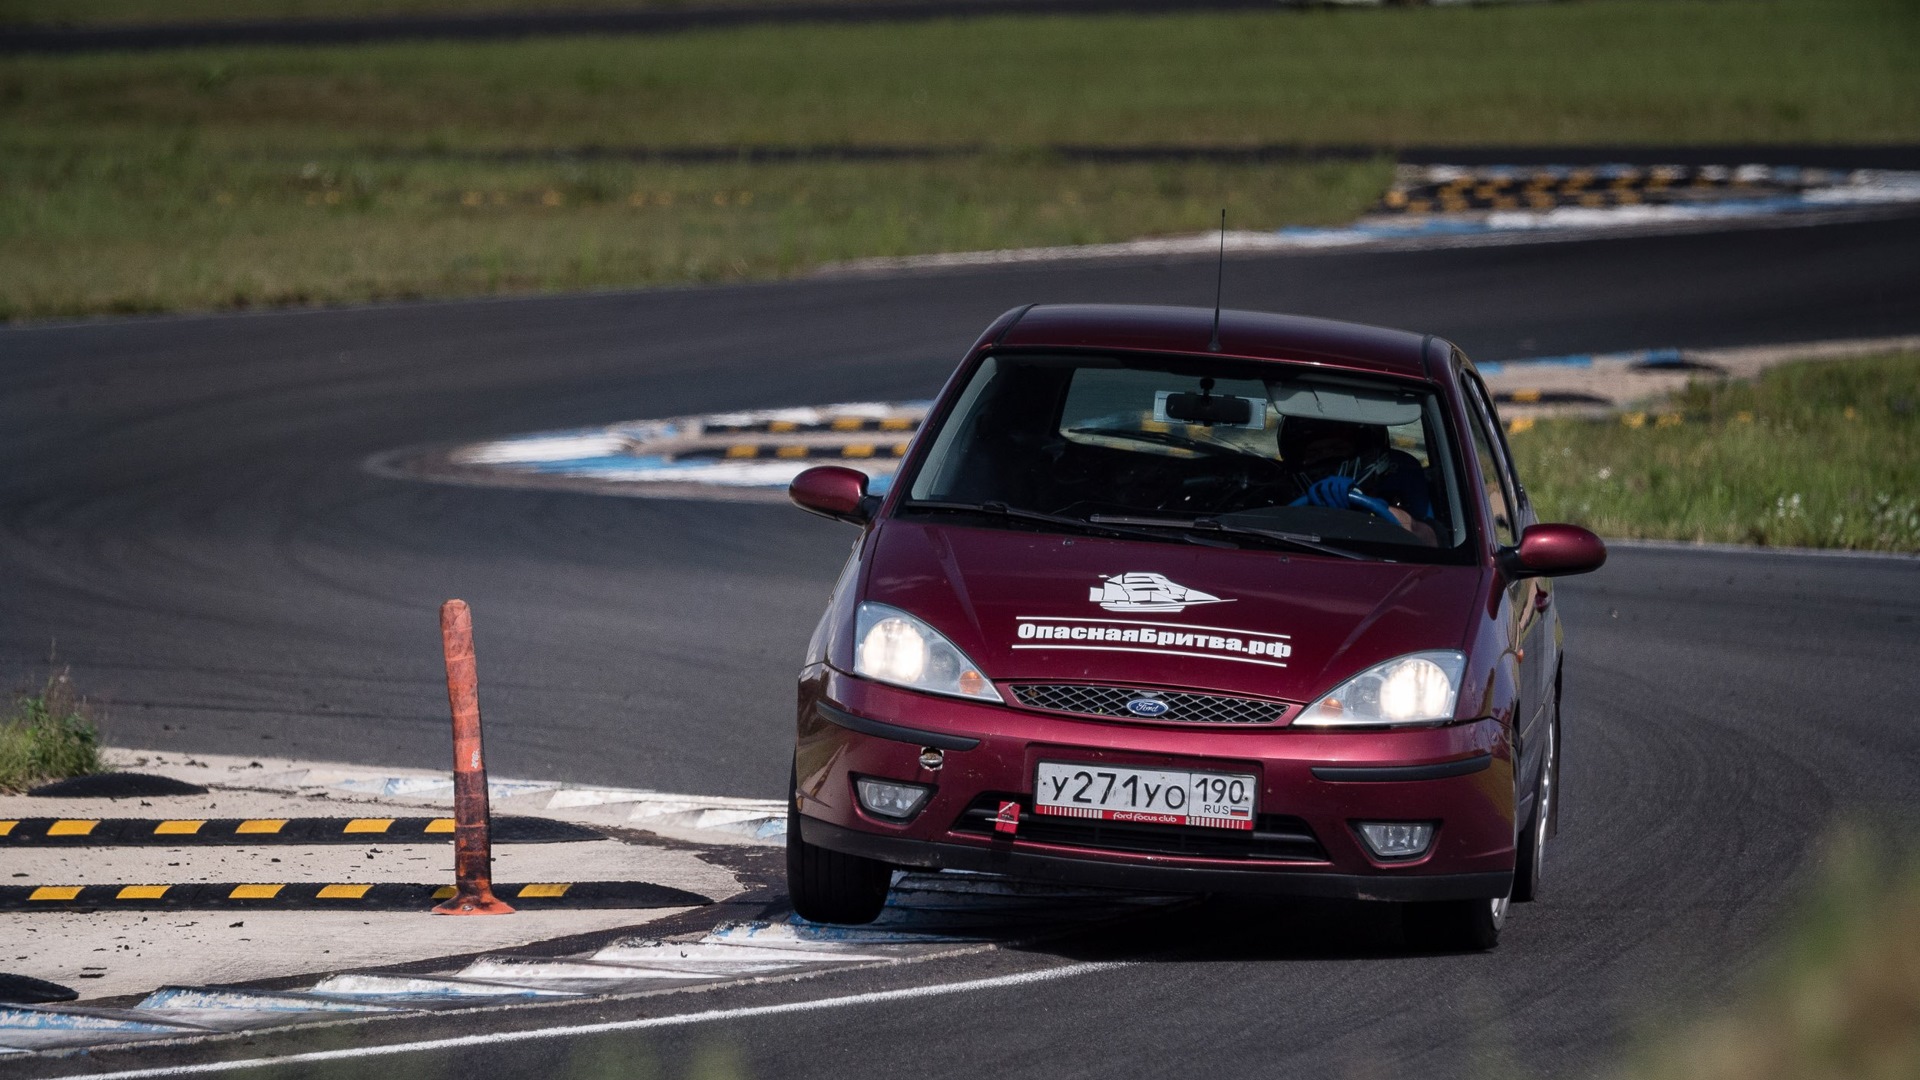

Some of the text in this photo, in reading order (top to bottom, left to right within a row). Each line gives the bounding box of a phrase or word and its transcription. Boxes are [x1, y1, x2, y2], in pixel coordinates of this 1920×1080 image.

[1017, 623, 1291, 658] ОпаснаяБритва.рф
[1136, 702, 1159, 712] Ford
[1195, 777, 1245, 804] 190
[1203, 804, 1229, 815] RUS
[1133, 813, 1157, 822] focus
